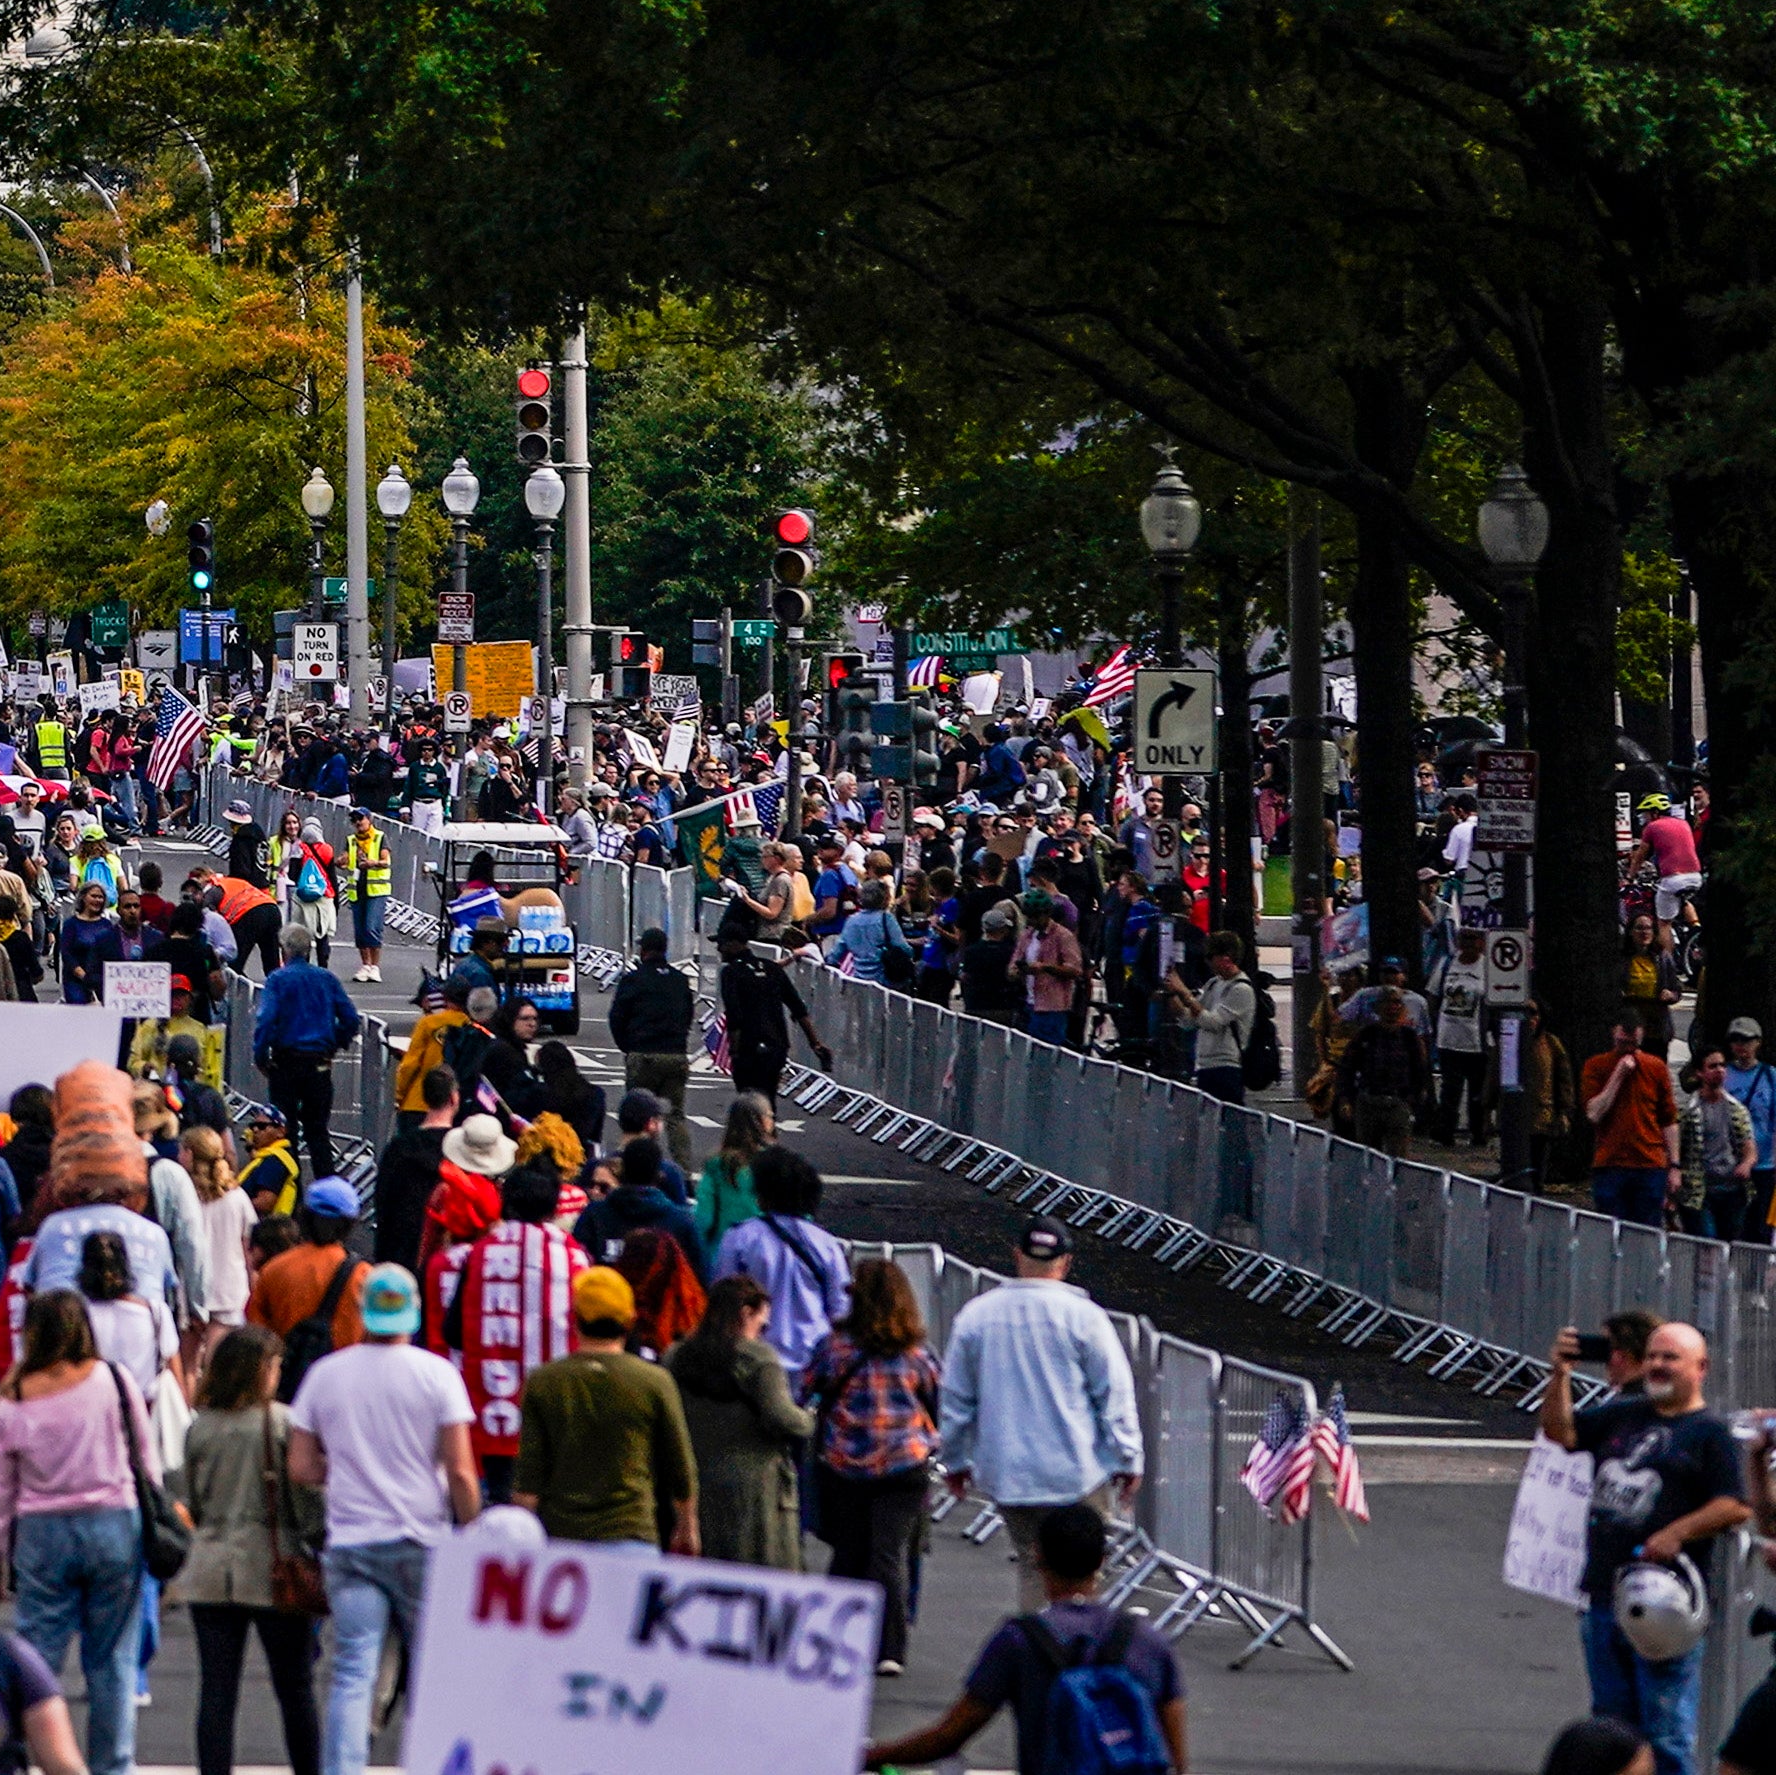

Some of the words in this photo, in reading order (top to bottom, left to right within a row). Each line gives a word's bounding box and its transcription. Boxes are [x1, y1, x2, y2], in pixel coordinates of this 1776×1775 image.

[94, 617, 127, 626] TRUCKS
[306, 626, 327, 639] NO
[744, 623, 752, 635] 4
[303, 640, 329, 651] TURN
[745, 636, 762, 645] 100
[296, 652, 312, 663] ON
[314, 652, 335, 663] RED
[1145, 745, 1205, 765] ONLY
[481, 1357, 524, 1437] DC
[474, 1558, 591, 1635] NO
[634, 1570, 874, 1692] KINGS
[559, 1673, 667, 1723] IN
